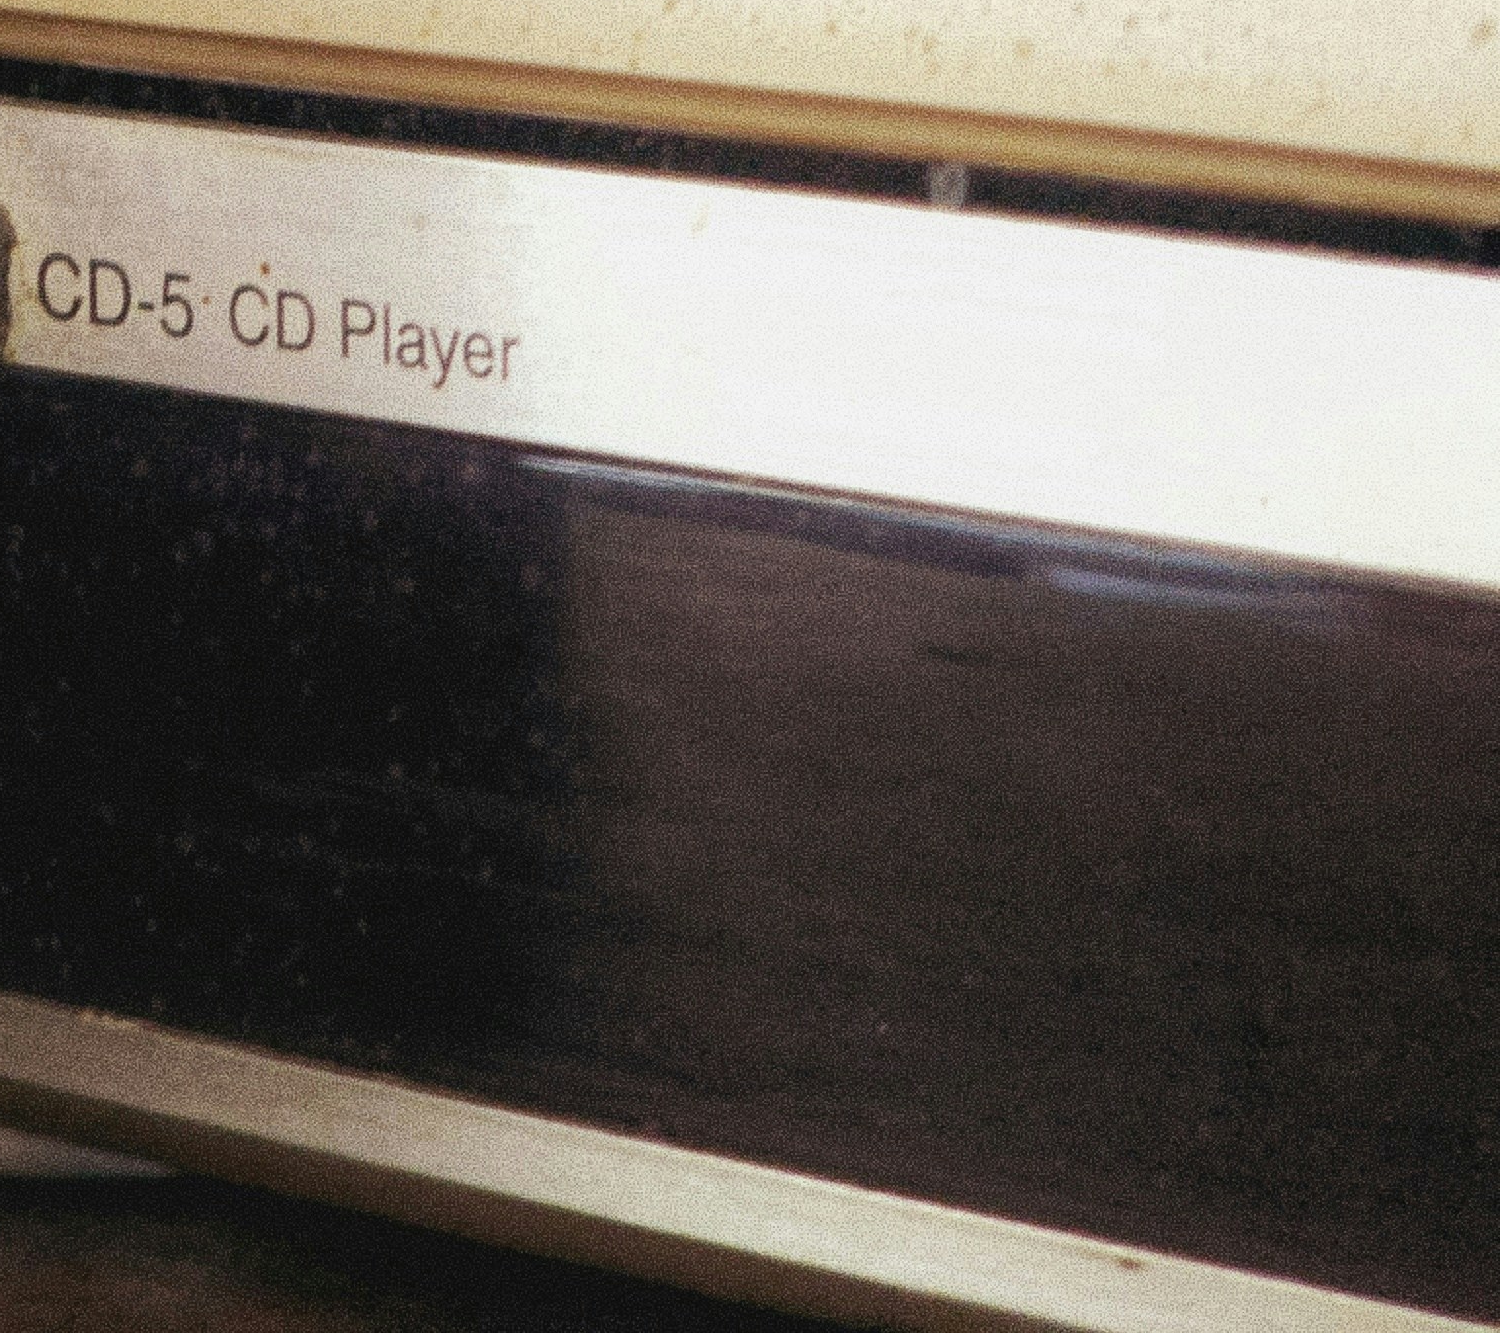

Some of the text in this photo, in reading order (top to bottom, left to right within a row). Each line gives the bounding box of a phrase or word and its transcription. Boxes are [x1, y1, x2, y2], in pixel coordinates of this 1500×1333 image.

[36, 251, 194, 339] CD-5
[228, 283, 316, 352] CD
[340, 297, 520, 391] Player
